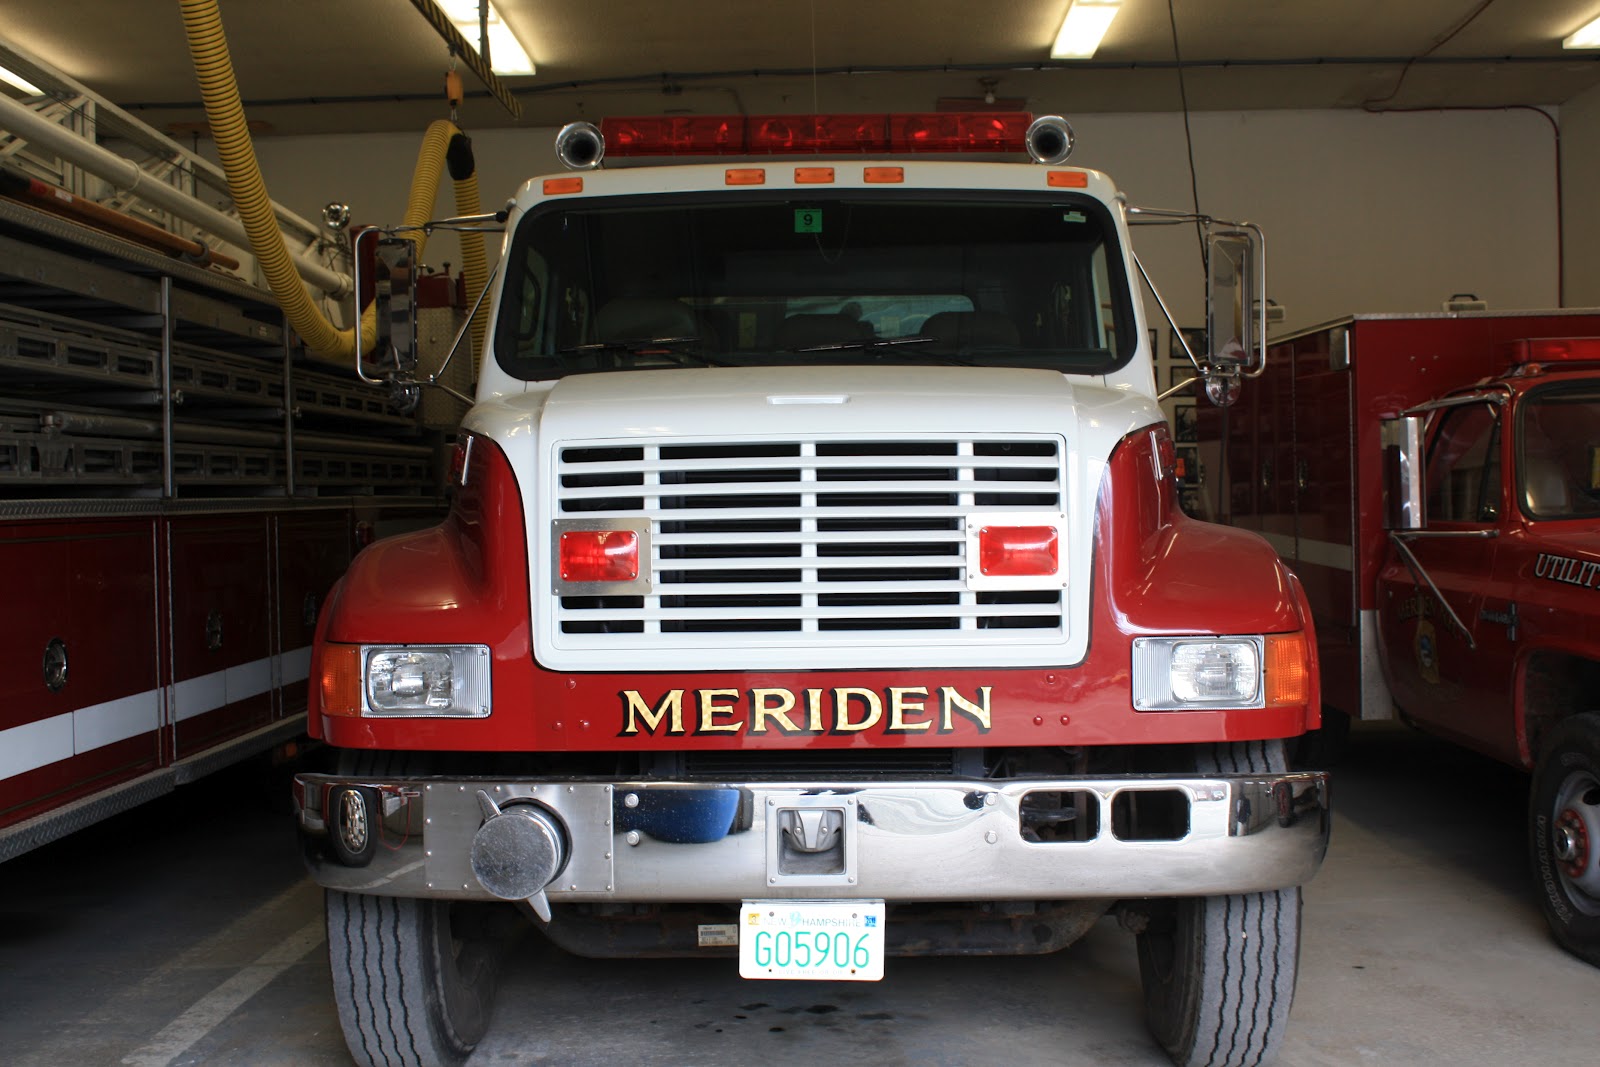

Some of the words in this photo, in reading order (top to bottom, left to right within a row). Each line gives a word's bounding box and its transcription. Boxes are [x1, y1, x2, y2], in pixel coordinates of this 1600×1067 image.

[803, 213, 813, 226] 9
[1535, 553, 1600, 589] UTILIT
[617, 686, 993, 737] MERIDEN
[764, 917, 787, 926] NEW
[802, 918, 861, 927] HAMPSHIRE
[755, 931, 870, 968] G05906
